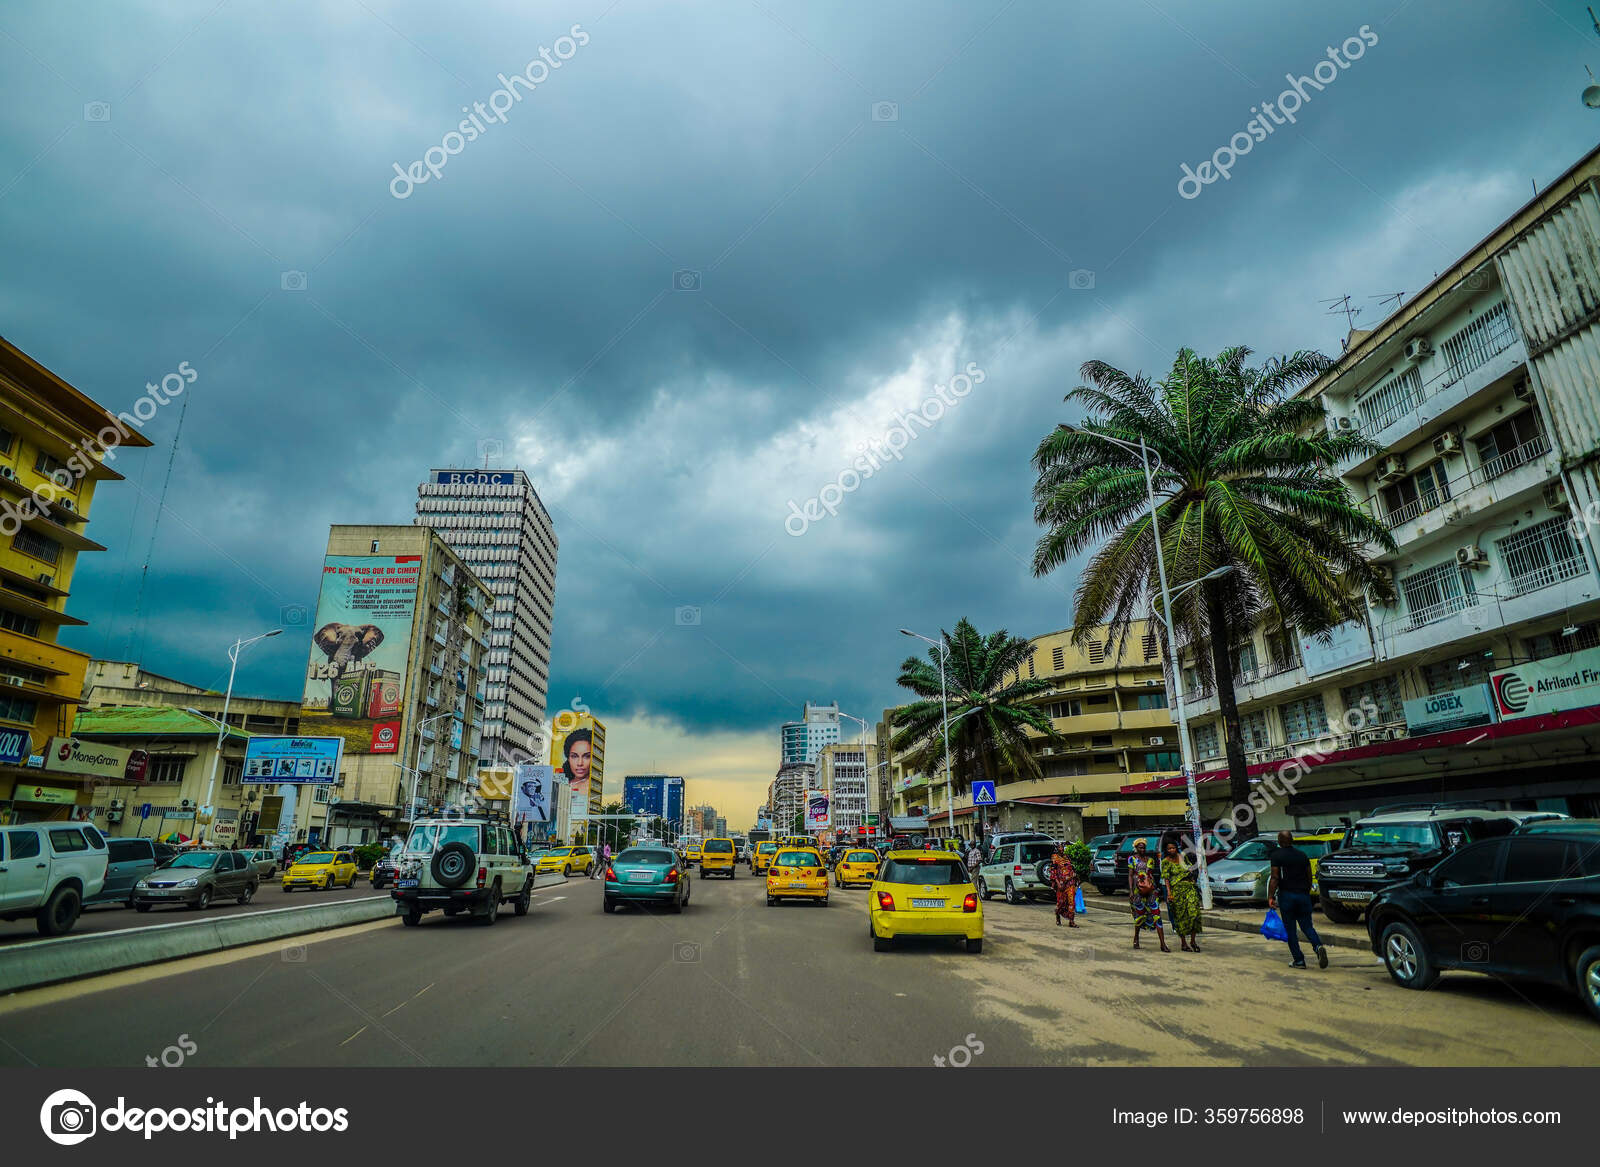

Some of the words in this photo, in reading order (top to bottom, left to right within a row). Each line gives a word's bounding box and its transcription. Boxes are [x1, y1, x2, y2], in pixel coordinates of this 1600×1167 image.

[450, 474, 502, 485] BCDC
[323, 566, 337, 574] PPC
[349, 576, 360, 584] 126
[309, 661, 340, 680] 126
[1538, 671, 1580, 693] Afriland
[1425, 696, 1464, 714] LOBEX
[71, 750, 119, 767] MoneyGram
[215, 824, 236, 834] Canon
